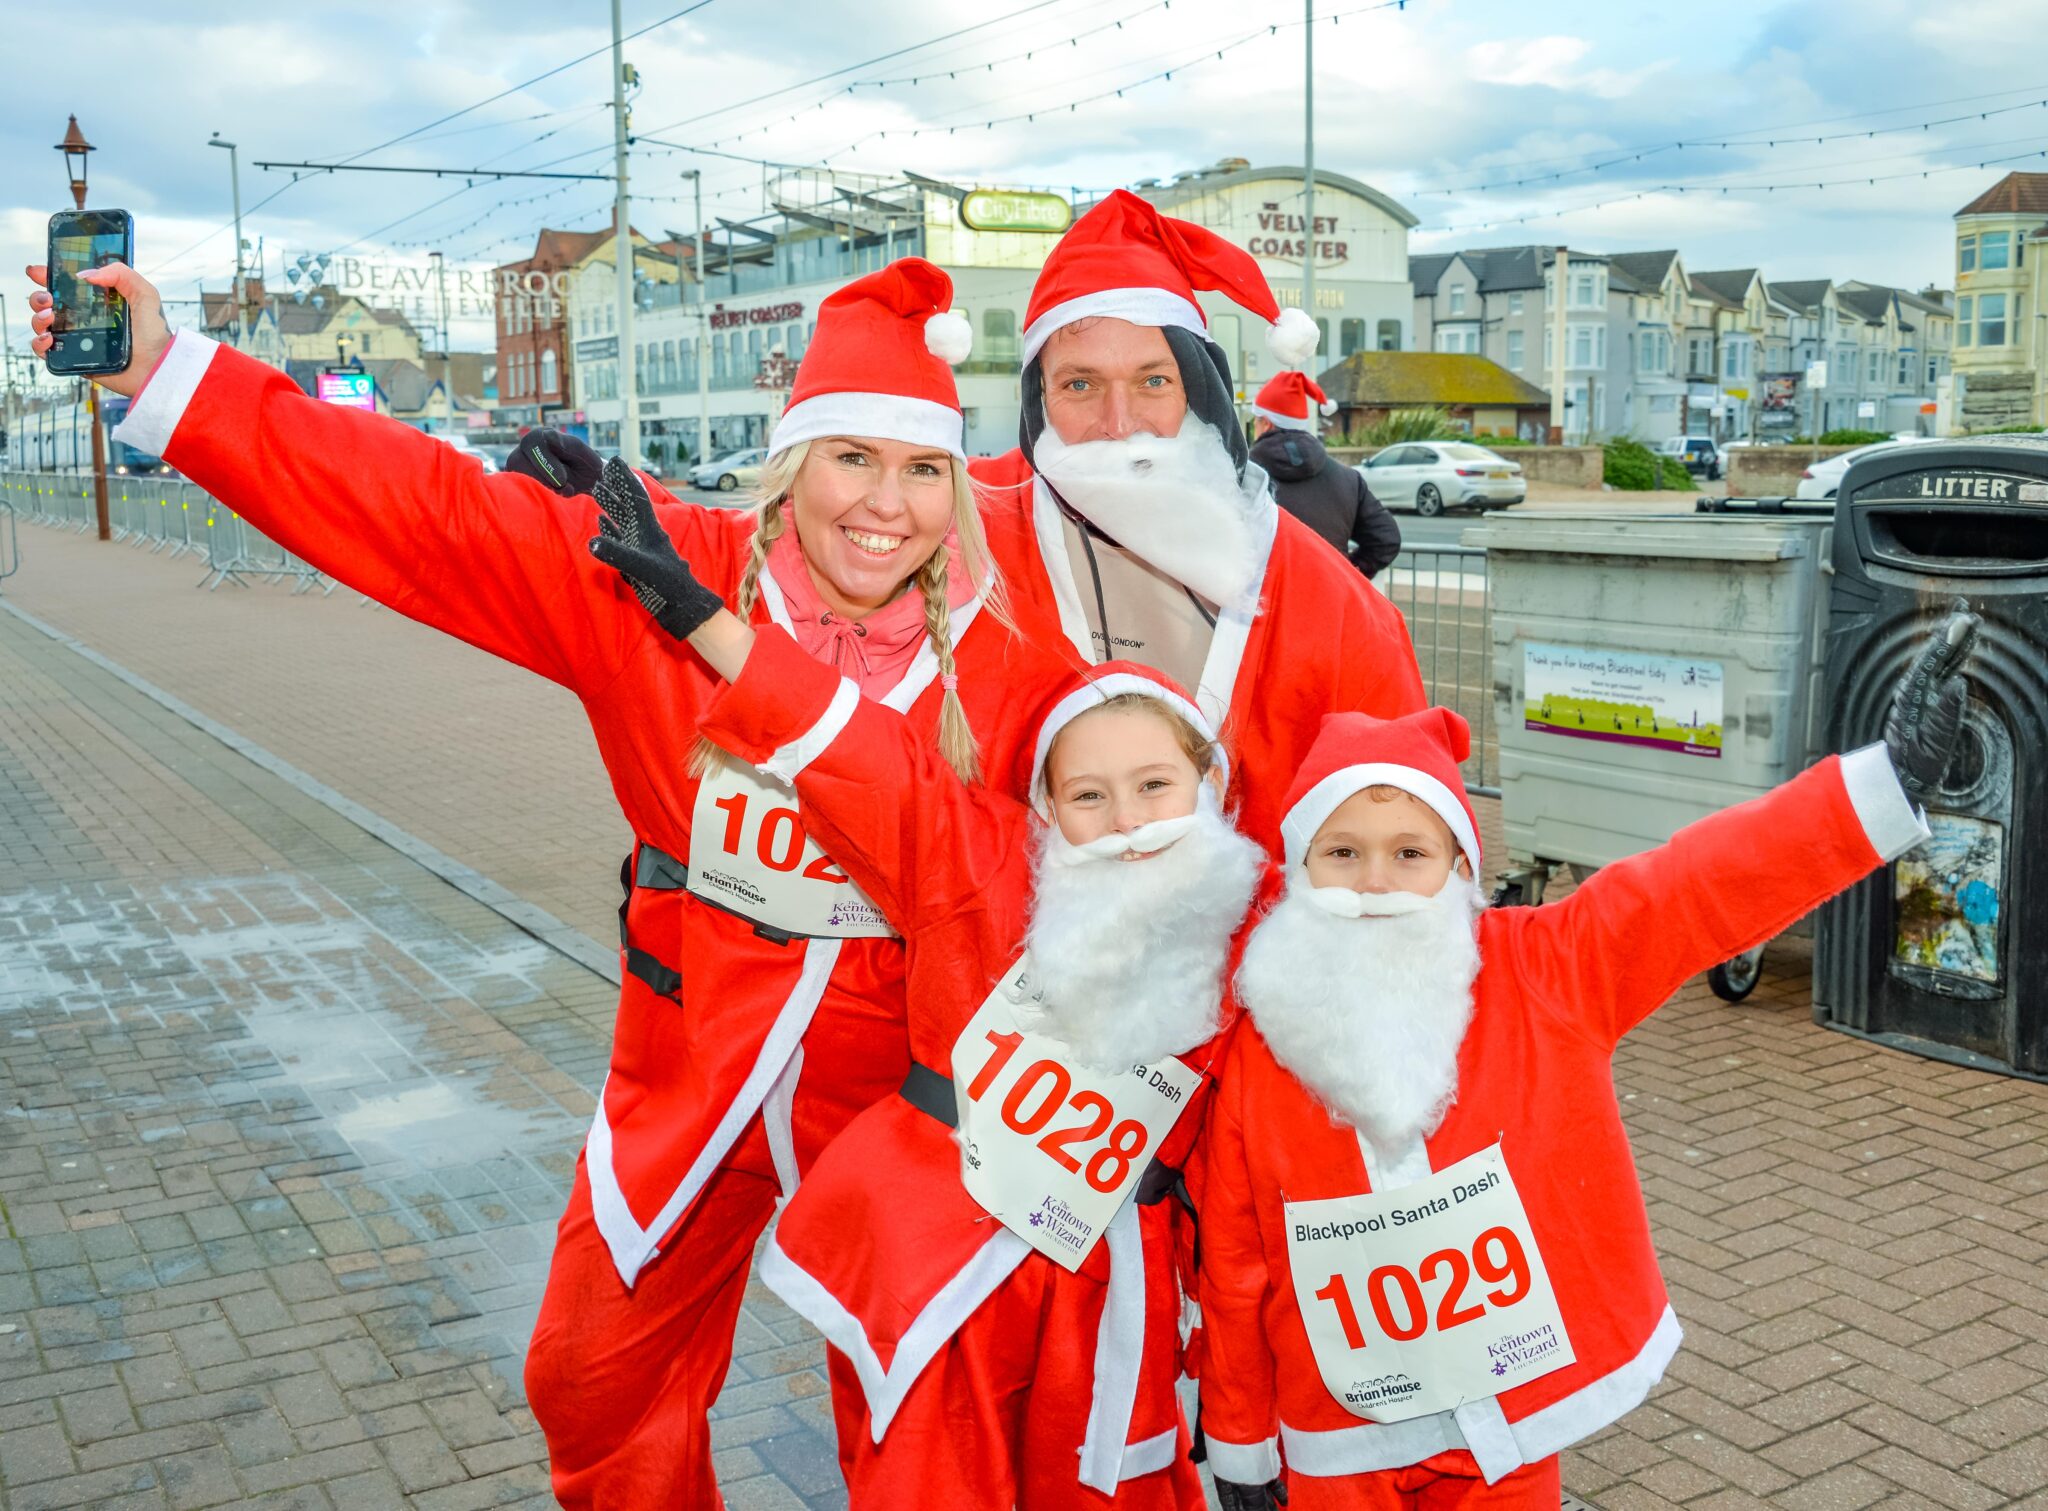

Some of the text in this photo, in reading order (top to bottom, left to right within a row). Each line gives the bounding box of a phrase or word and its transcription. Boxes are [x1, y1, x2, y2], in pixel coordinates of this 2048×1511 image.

[976, 197, 1058, 224] CityFibre
[1257, 213, 1339, 234] VELVET
[1248, 237, 1349, 260] COASTER
[1921, 477, 2008, 498] LITTER
[1551, 660, 1562, 671] you
[1564, 654, 1576, 668] for
[1607, 658, 1646, 677] Blackpool
[715, 792, 849, 884] 102
[702, 870, 767, 905] Brian House
[833, 903, 883, 915] Kentow
[842, 912, 889, 926] Wizar
[1148, 1070, 1182, 1104] Dash
[966, 1029, 1149, 1194] 1028
[1041, 1194, 1093, 1236] Kentown
[1295, 1171, 1500, 1242] Blackpool Santa Dash
[1046, 1214, 1088, 1250] Wizard
[1315, 1225, 1532, 1350] 1029
[1487, 1324, 1553, 1358] Kentown
[1502, 1333, 1558, 1365] Wizard
[1345, 1381, 1422, 1403] Brian House
[1357, 1394, 1413, 1409] Children's Hospice
